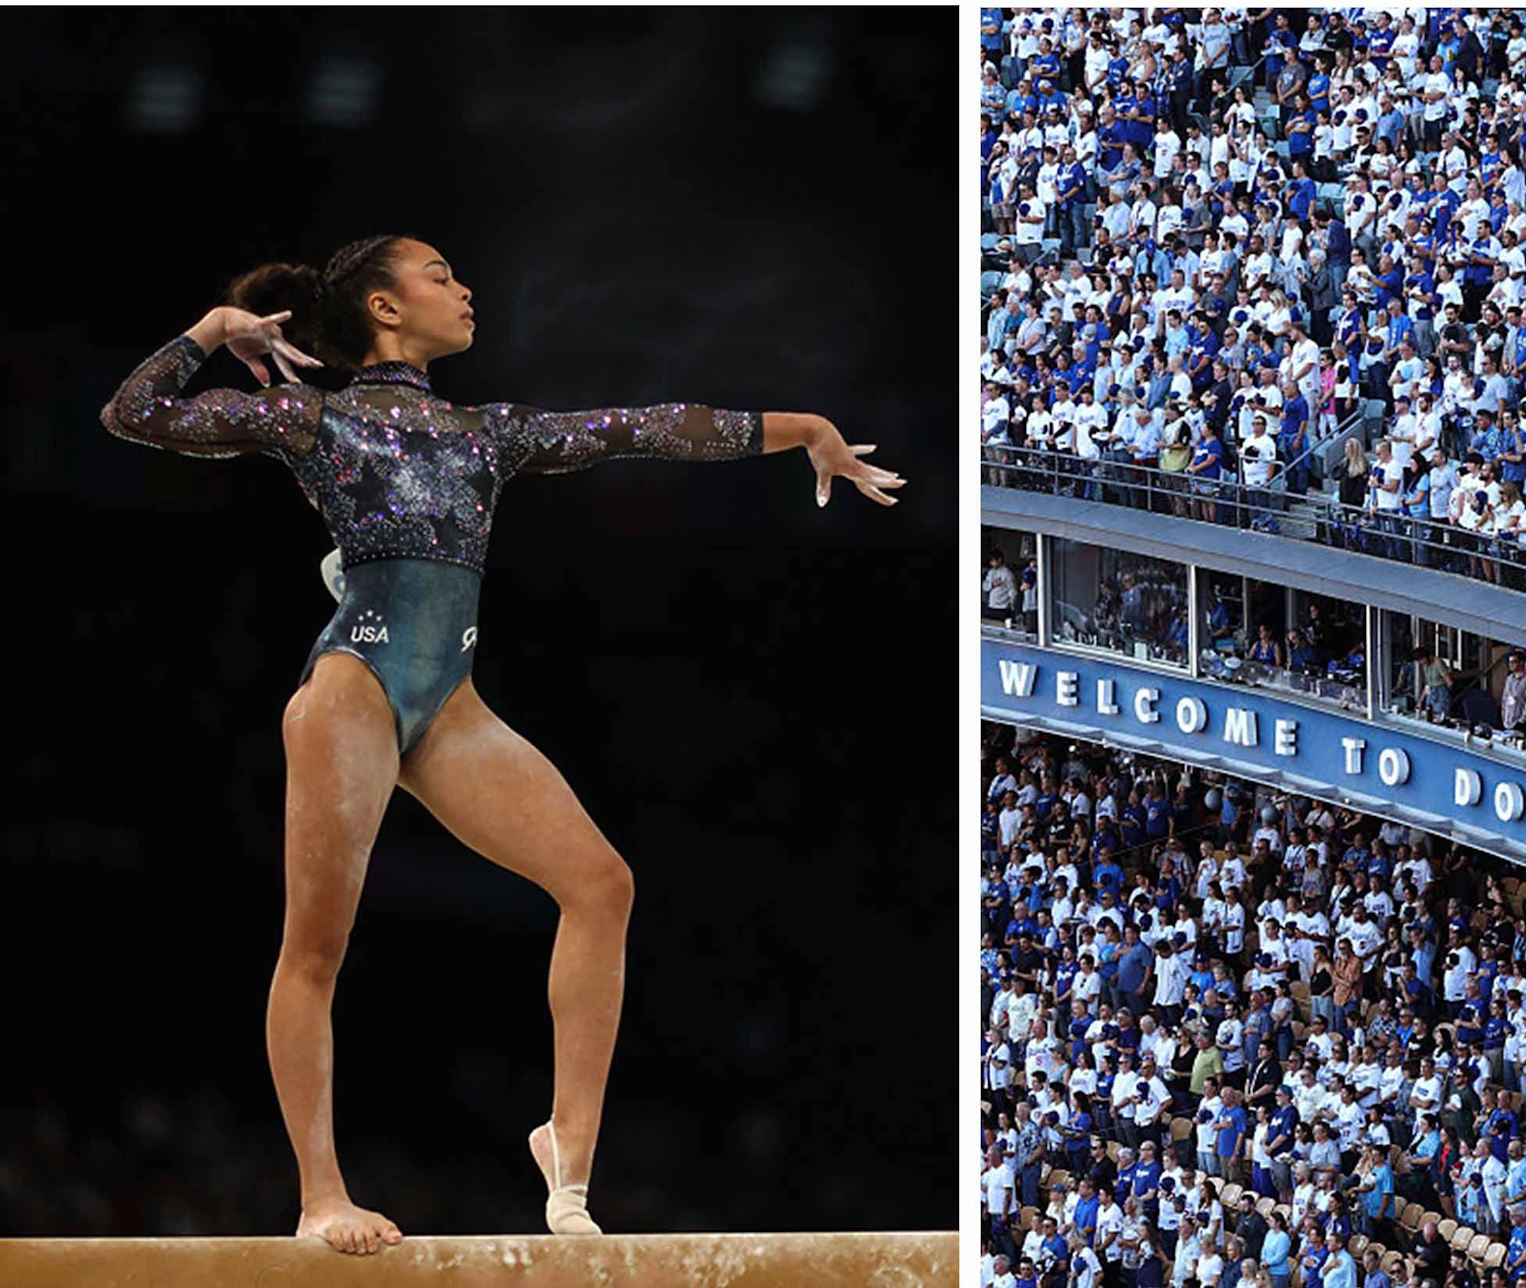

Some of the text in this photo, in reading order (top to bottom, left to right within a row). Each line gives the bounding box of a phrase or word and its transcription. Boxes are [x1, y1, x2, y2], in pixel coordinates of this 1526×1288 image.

[351, 626, 390, 643] USA
[999, 660, 1297, 756] WELCOME
[1341, 737, 1411, 786] TO
